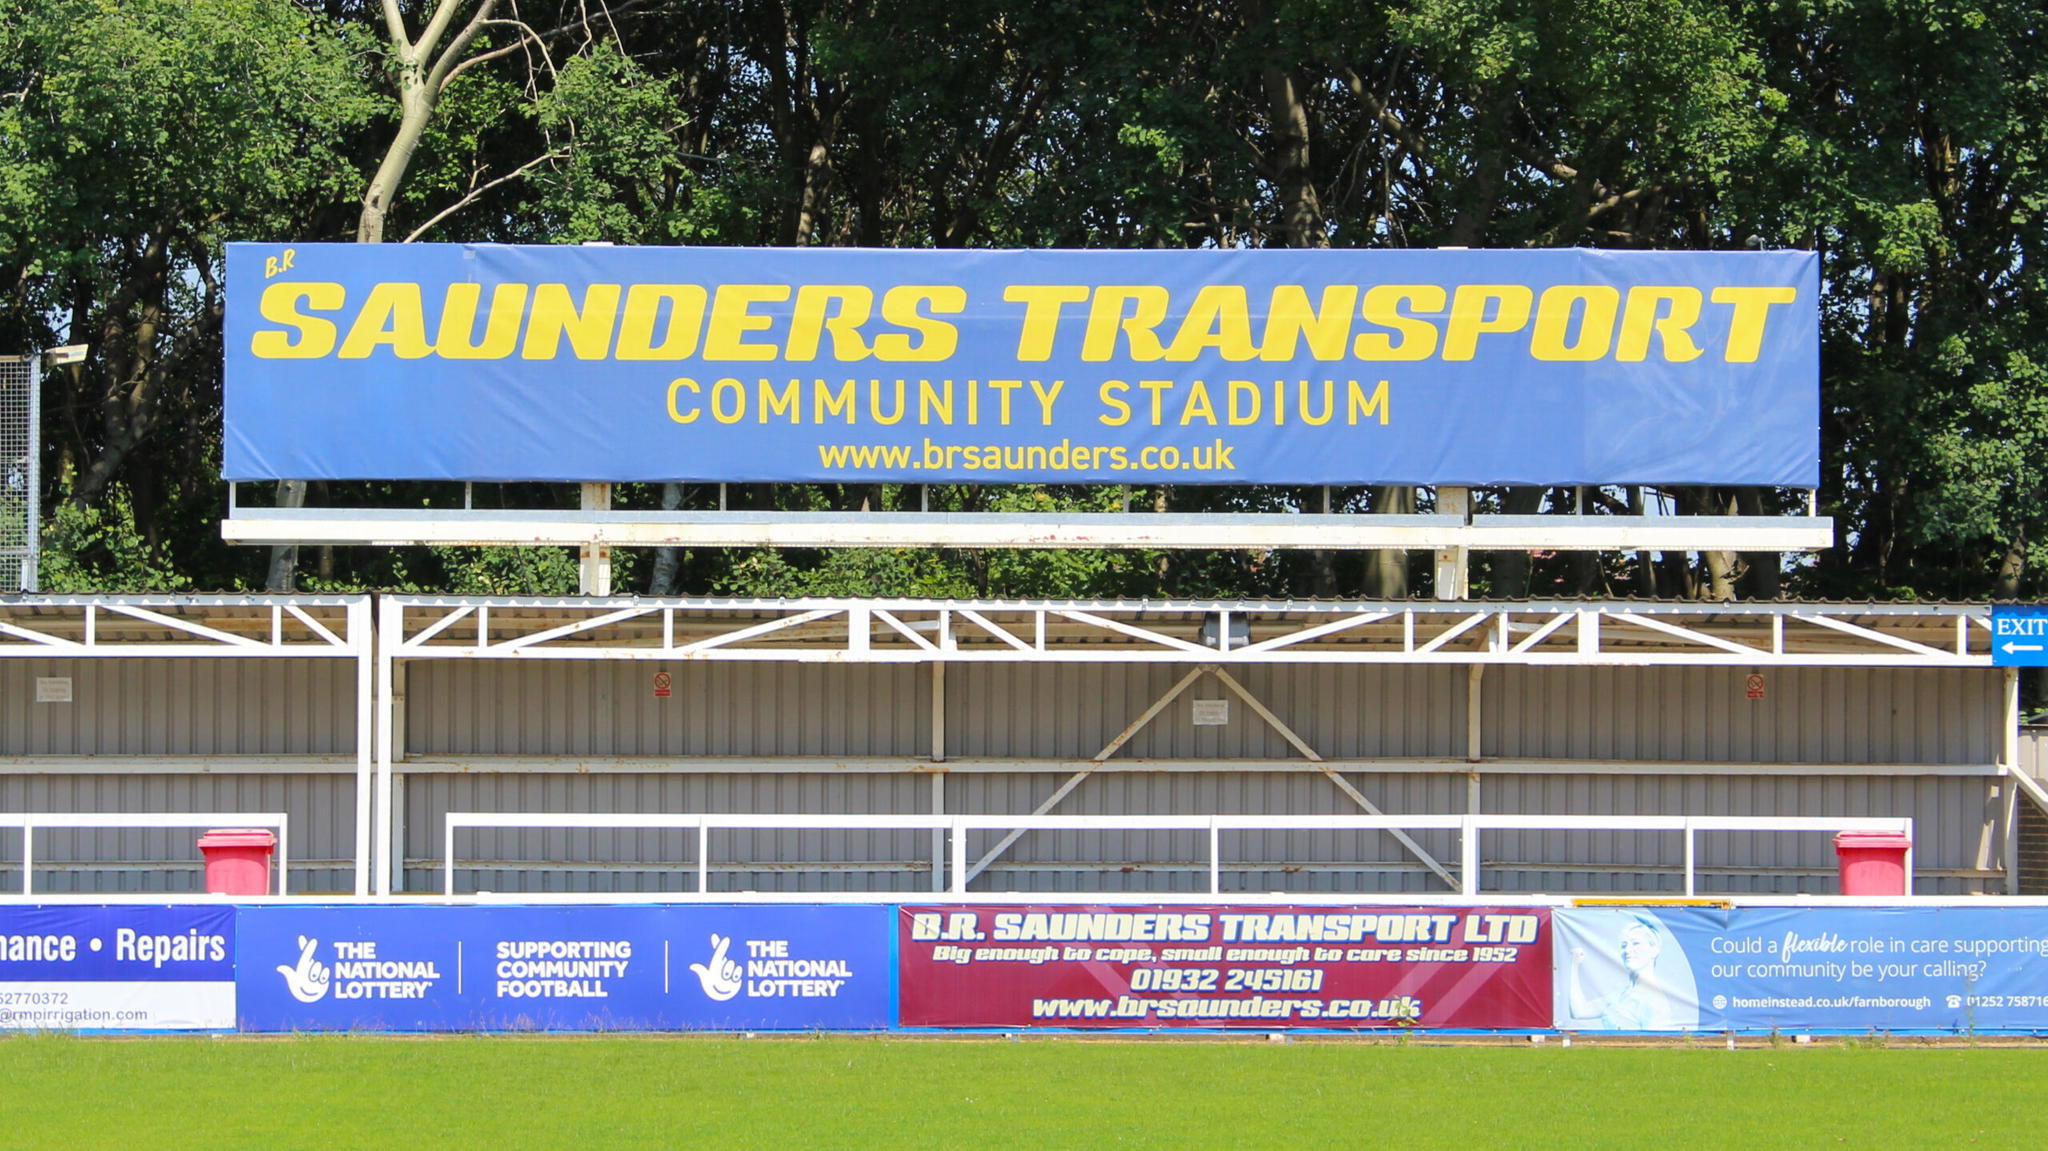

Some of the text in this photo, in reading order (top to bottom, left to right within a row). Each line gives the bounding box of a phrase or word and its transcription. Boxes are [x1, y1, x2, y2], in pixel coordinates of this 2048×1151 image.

[264, 248, 296, 279] B.R
[250, 282, 1797, 363] SAUNDERS TRANSPORT
[666, 377, 1391, 426] COMMUNITY STADIUM
[818, 437, 1235, 471] www.brsaunders.co.uk
[1997, 618, 2048, 635] EXIT
[911, 913, 1538, 943] B.R. SAUNDERS TRANSPORT LTD
[116, 928, 226, 968] Repairs
[334, 941, 376, 959] THE
[496, 940, 632, 959] SUPPORTING
[746, 940, 788, 958] THE
[933, 945, 1518, 965] Big enough to cope, small enough to care since 1952
[1711, 931, 2048, 962] Could a flexible role in care supporting
[335, 961, 441, 979] NATIONAL
[496, 960, 629, 979] COMMUNITY
[747, 960, 853, 978] NATIONAL
[1711, 960, 1987, 982] our community be your calling?
[497, 980, 608, 998] FOOTBALL
[747, 980, 842, 998] LOTTERY
[1130, 968, 1324, 992] 01932 245161
[335, 981, 430, 999] LOTTERY
[1033, 996, 1421, 1019] www.brsaunders.co.uk
[1733, 995, 1931, 1009] homeinstead.co.uk/farnborough
